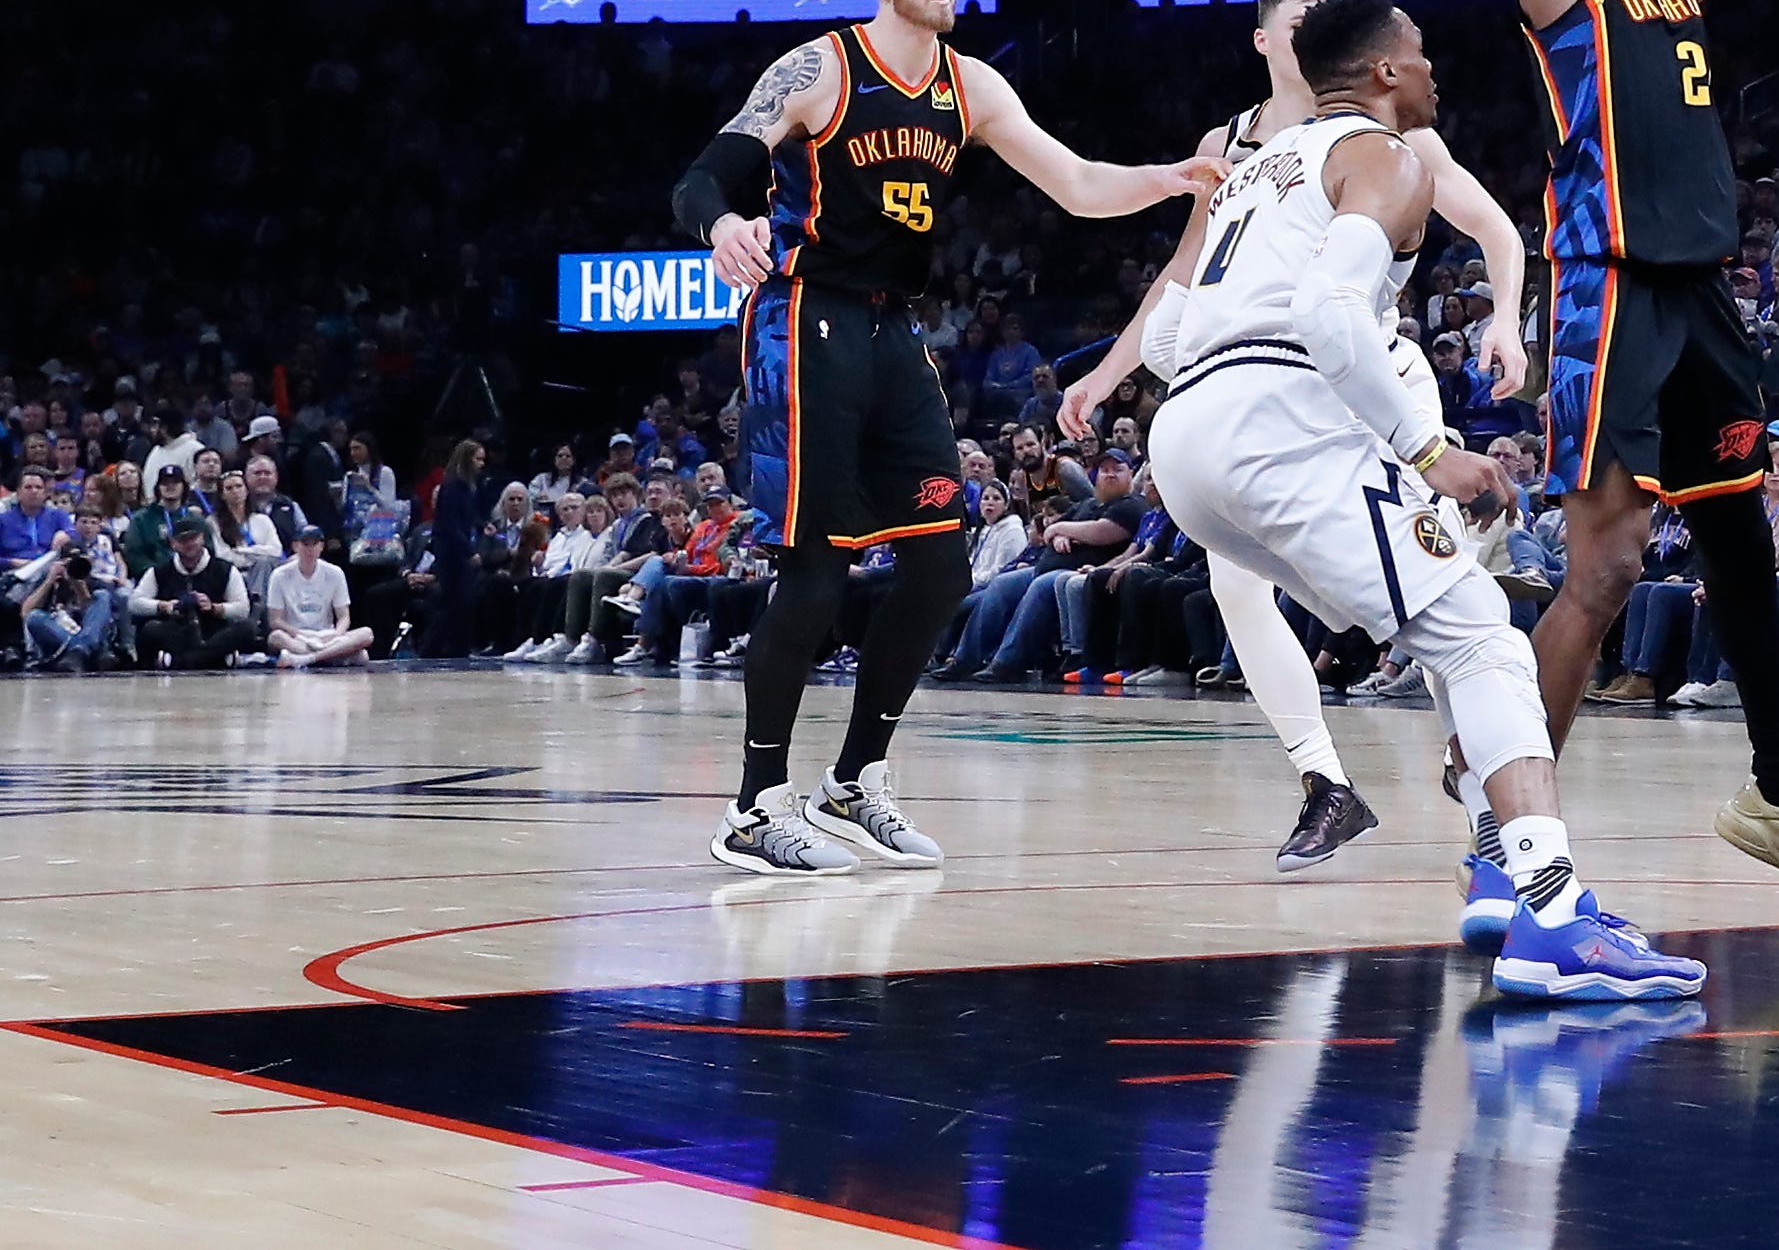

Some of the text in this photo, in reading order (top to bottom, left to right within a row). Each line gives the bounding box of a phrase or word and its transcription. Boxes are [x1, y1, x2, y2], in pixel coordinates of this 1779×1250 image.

[1675, 40, 1712, 106] 2
[847, 126, 958, 175] OKLAHOMA
[882, 180, 934, 233] 55
